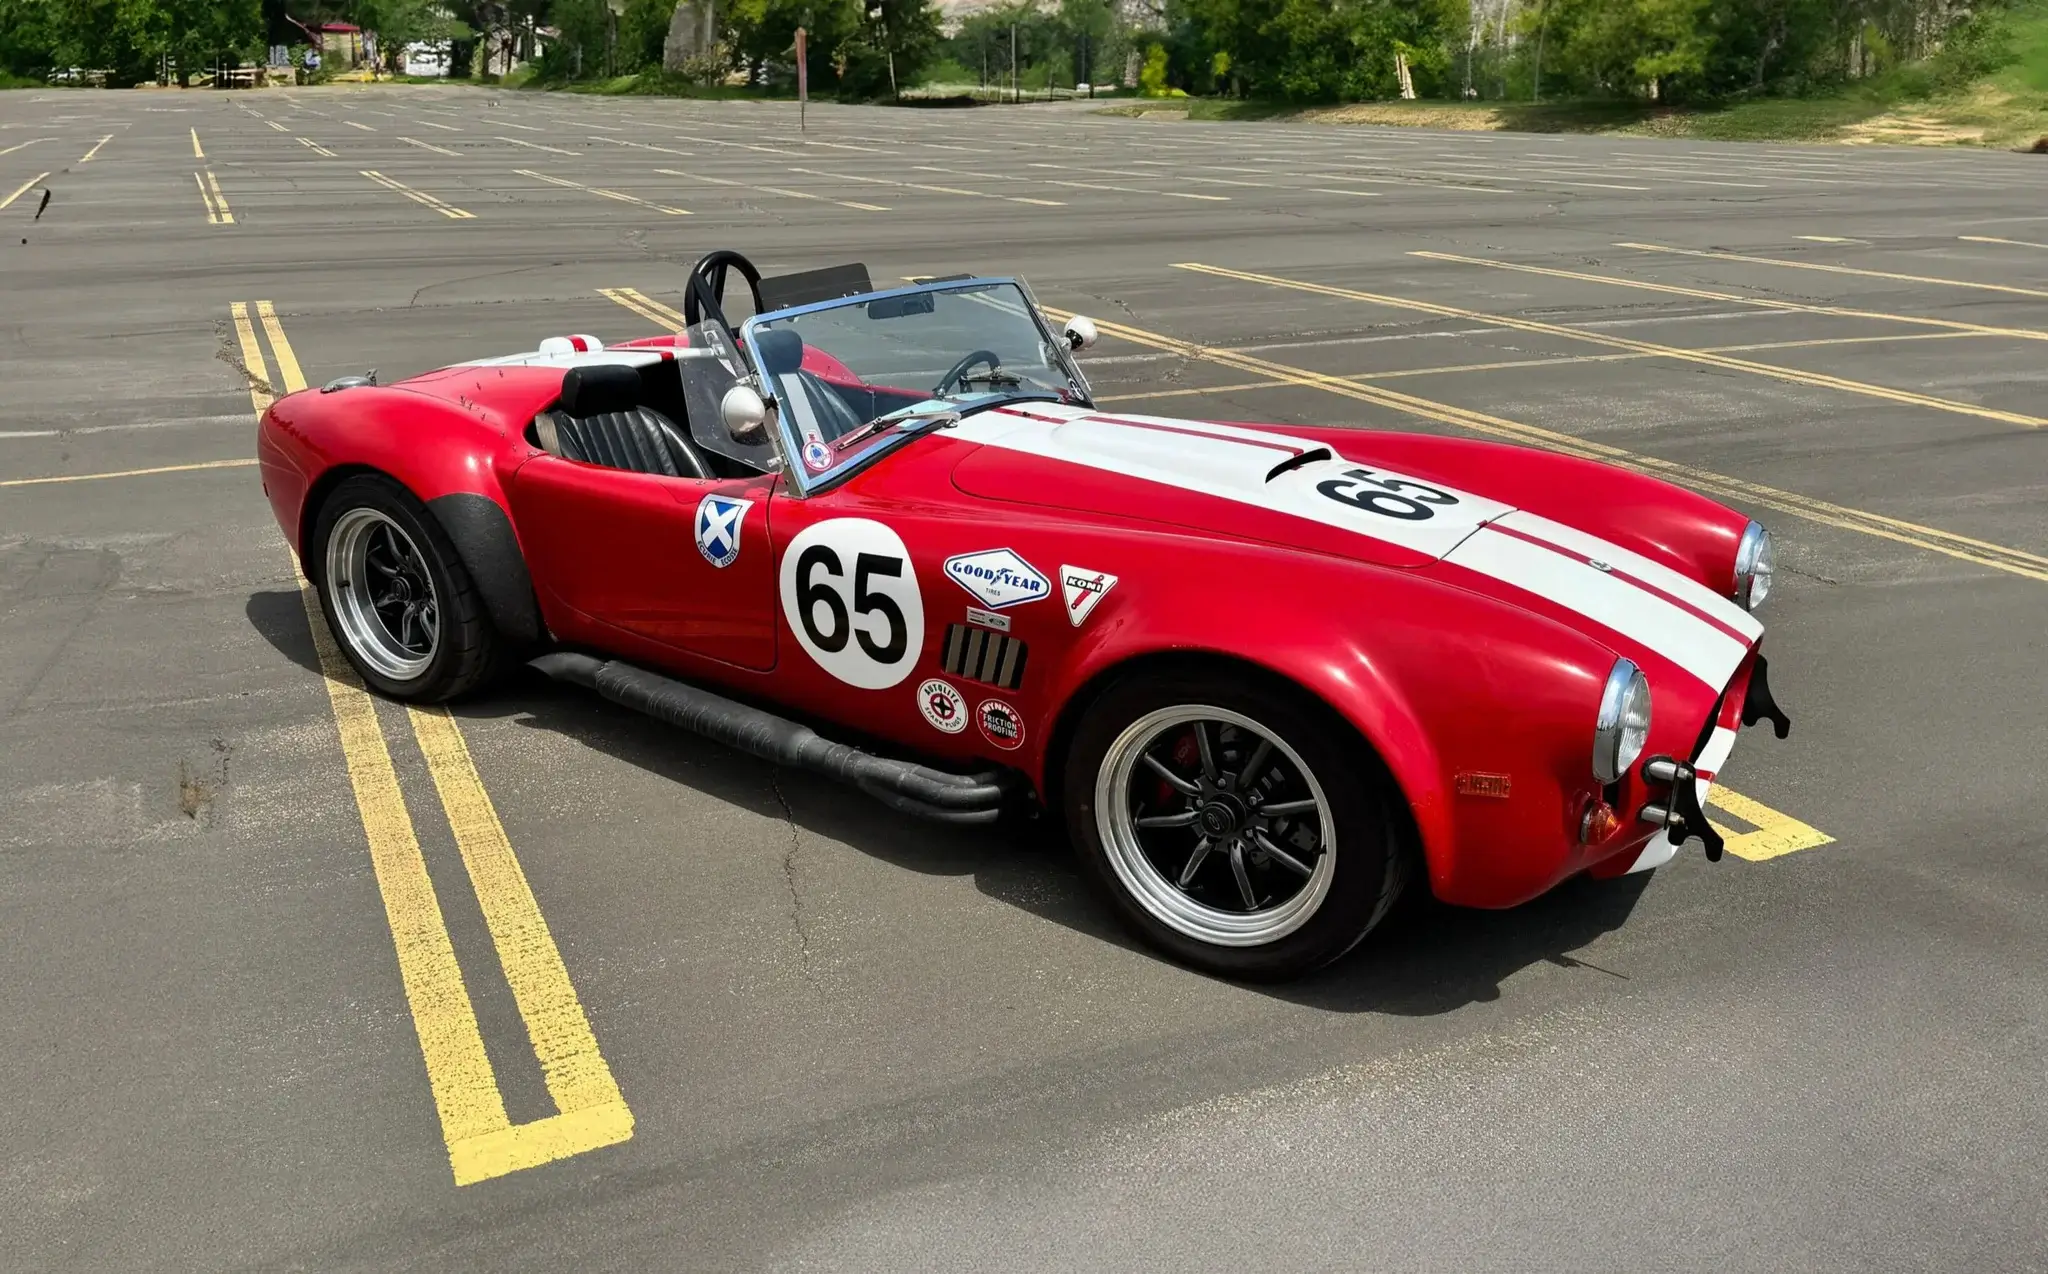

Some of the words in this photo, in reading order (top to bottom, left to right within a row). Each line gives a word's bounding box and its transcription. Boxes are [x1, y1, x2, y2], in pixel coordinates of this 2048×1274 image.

[1316, 469, 1460, 521] 65
[985, 587, 1001, 597] TIRES
[1067, 577, 1102, 592] KONI
[796, 545, 908, 665] 65
[924, 683, 960, 706] AUTOLITE
[924, 706, 944, 726] SPARK
[945, 716, 962, 728] PLUGS
[981, 702, 1018, 722] WYNN'S
[982, 713, 1018, 731] FRICTION
[983, 720, 1018, 738] PROOFING
